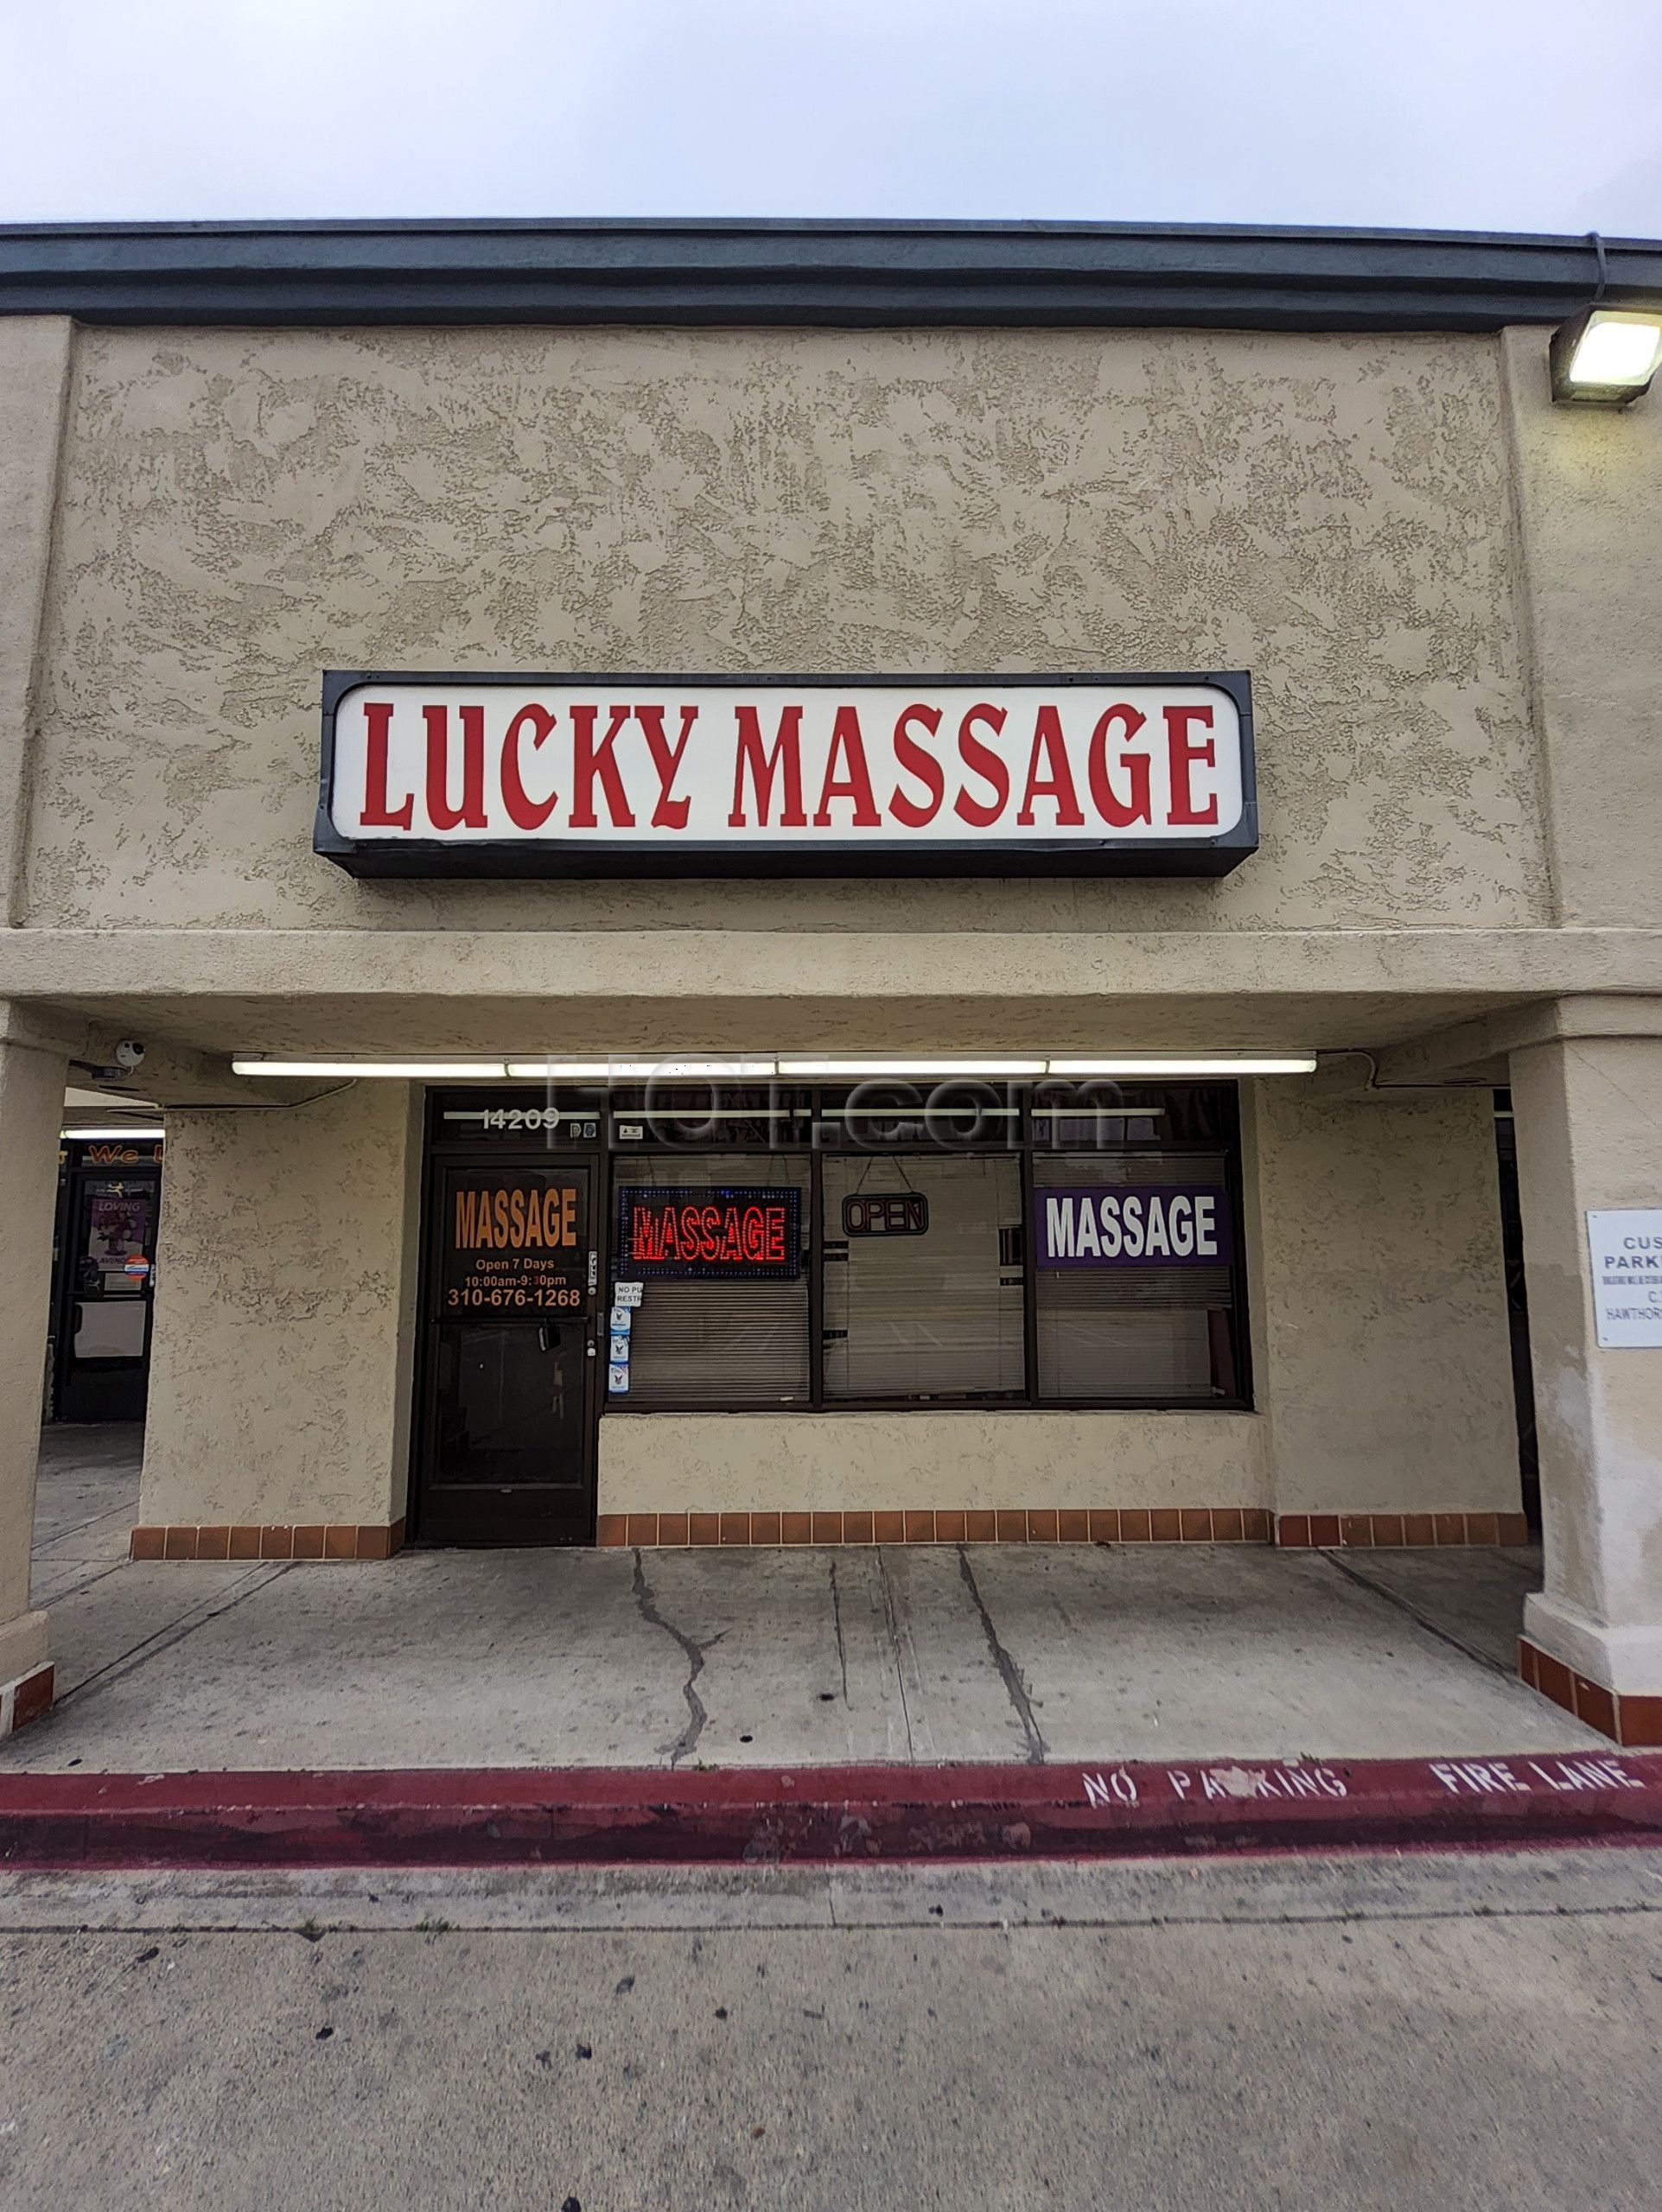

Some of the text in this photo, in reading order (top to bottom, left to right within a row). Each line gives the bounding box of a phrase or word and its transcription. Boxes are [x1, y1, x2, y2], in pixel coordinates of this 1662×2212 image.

[360, 702, 1219, 830] LUCKY MASSAGE
[481, 1107, 560, 1130] 14209
[89, 1145, 139, 1163] We
[99, 1202, 140, 1211] LOVING
[455, 1188, 576, 1249] MASSAGE
[847, 1198, 924, 1231] OPEN
[632, 1206, 786, 1262] MASSAGE
[1046, 1195, 1217, 1258] MASSAGE
[475, 1258, 554, 1273] Open 7 Days
[1604, 1255, 1662, 1268] PARK
[448, 1289, 581, 1306] 310-676-1268
[1082, 1768, 1347, 1807] NO PAKING
[1429, 1759, 1646, 1795] FIRE LANE
